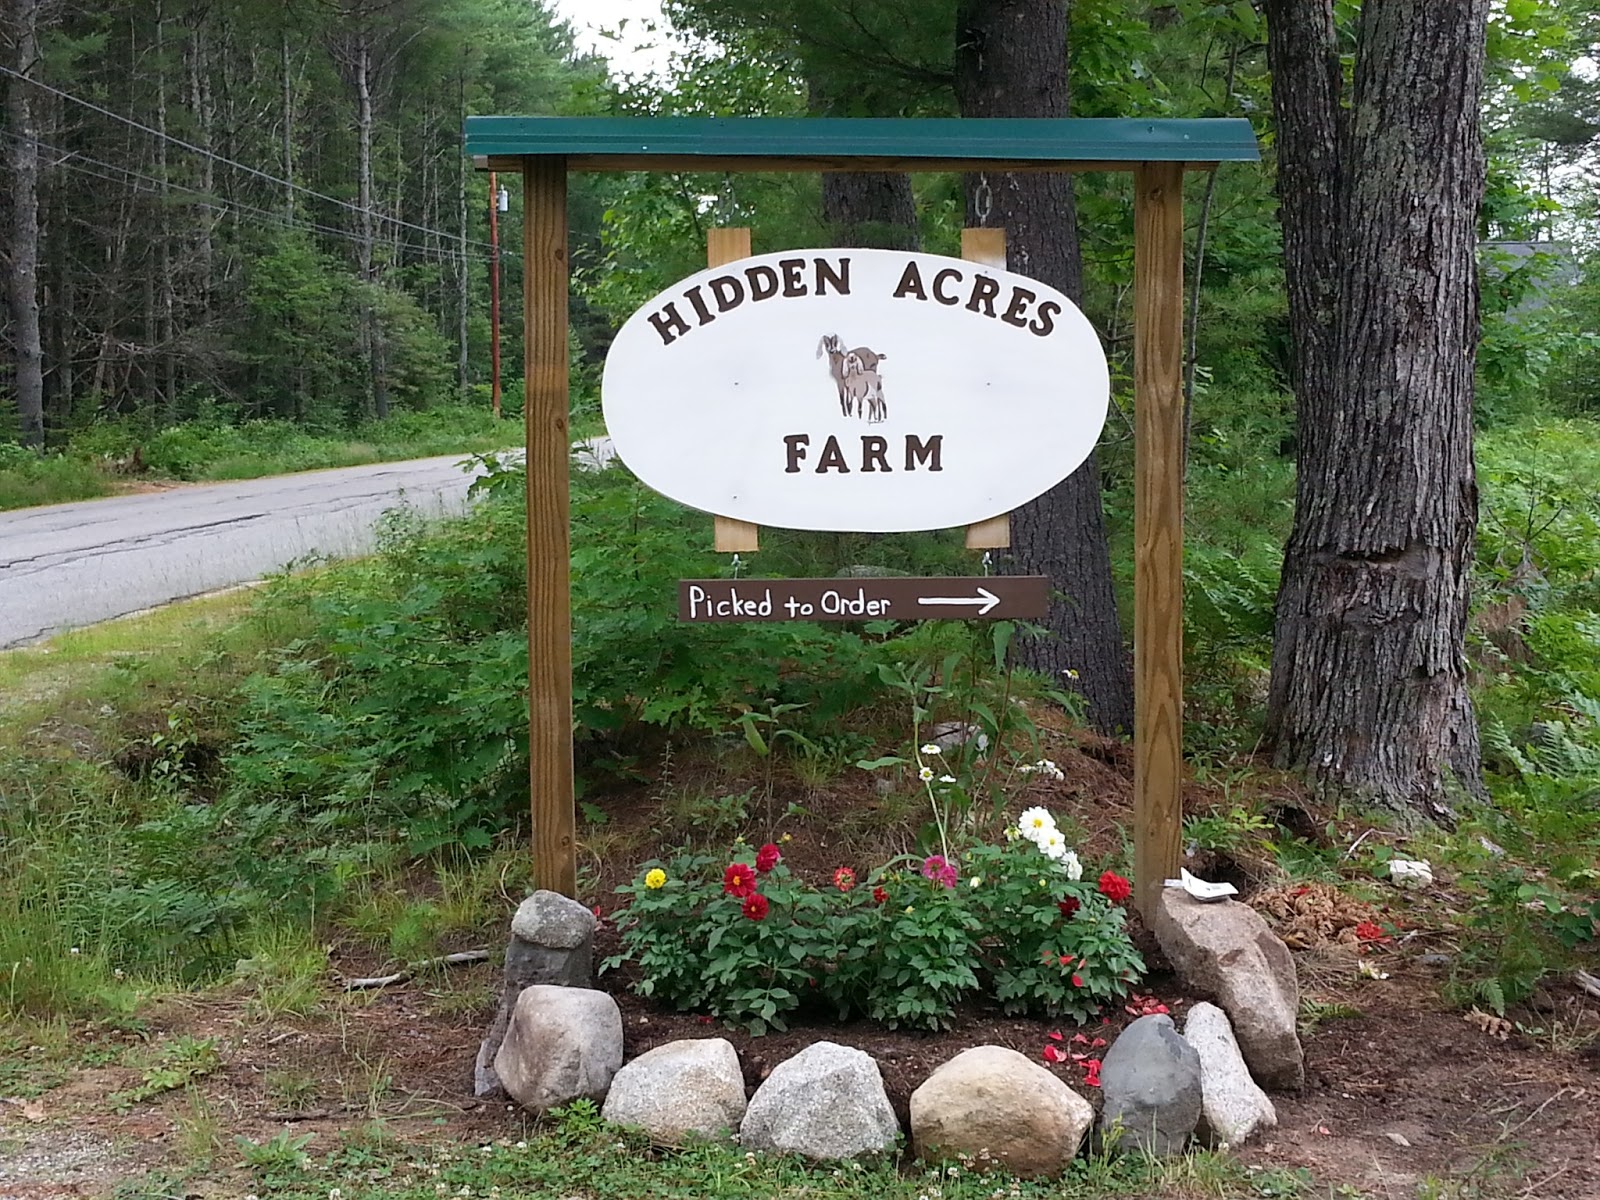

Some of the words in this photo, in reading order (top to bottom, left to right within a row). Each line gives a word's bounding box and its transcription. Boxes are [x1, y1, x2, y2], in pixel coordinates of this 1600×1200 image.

[648, 258, 851, 345] HIDDEN
[893, 261, 1062, 337] ACRES
[784, 434, 944, 473] FARM
[689, 585, 772, 618] Picked
[784, 596, 814, 617] to
[820, 588, 891, 615] Order
